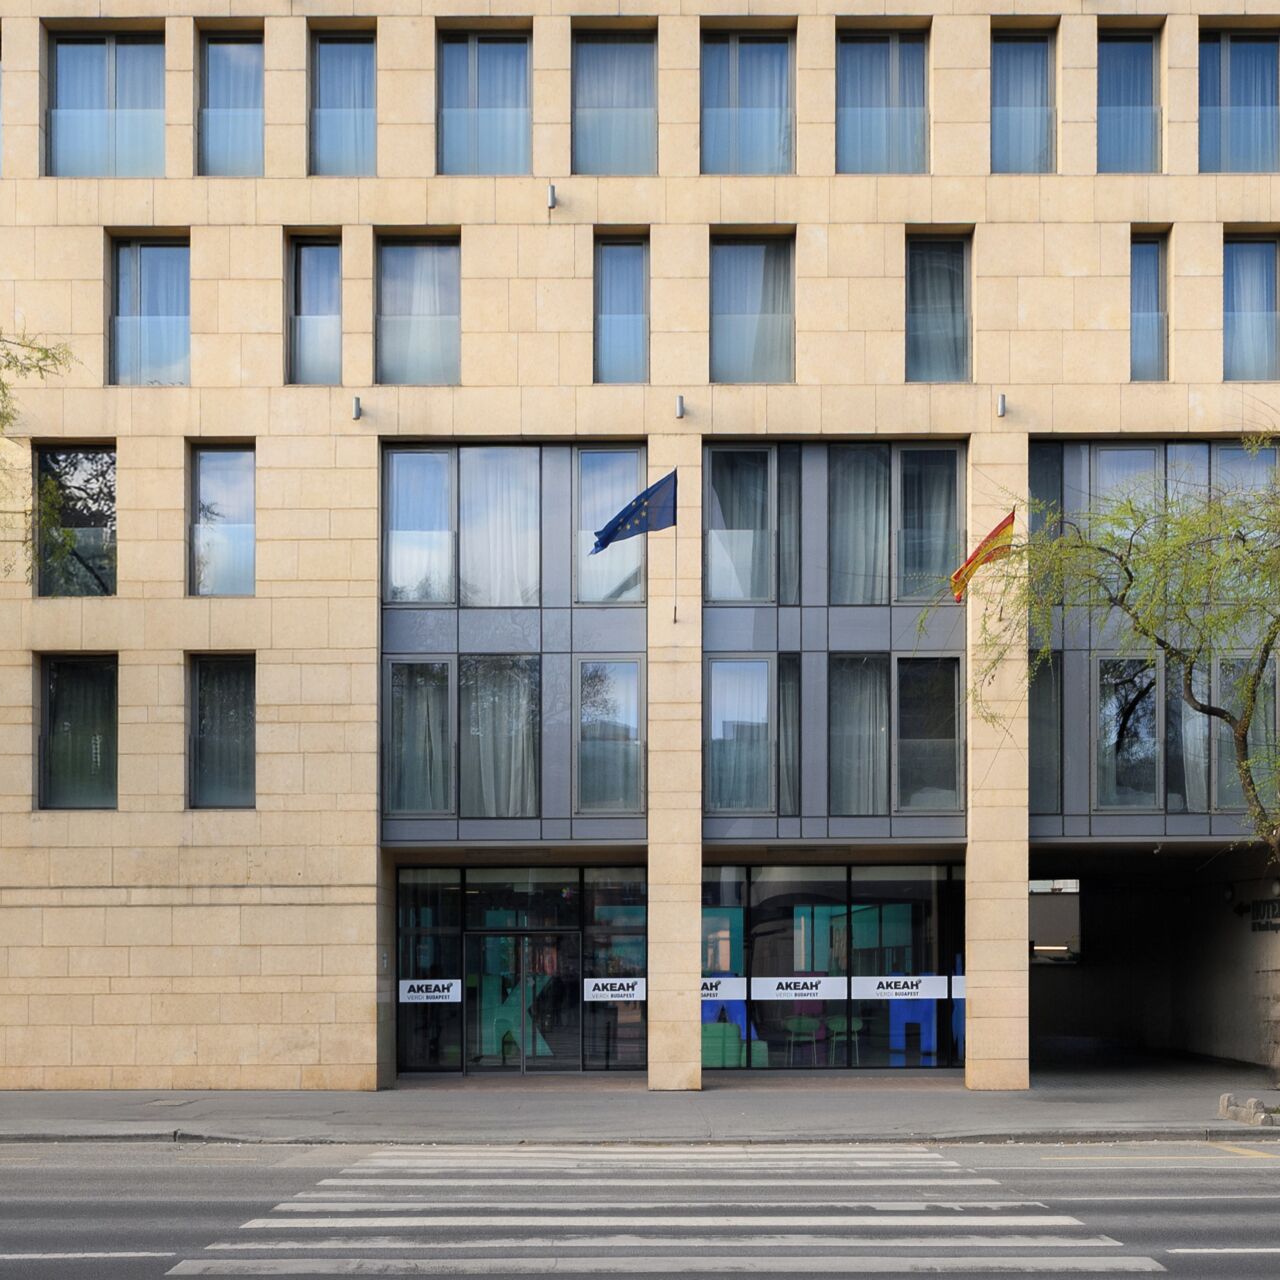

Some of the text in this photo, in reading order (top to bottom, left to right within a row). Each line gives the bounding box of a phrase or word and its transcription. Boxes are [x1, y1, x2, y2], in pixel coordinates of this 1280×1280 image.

[407, 983, 451, 994] AKEAH
[592, 982, 636, 992] AKEAH
[776, 980, 819, 991] AKEAH
[876, 979, 920, 990] AKEAH
